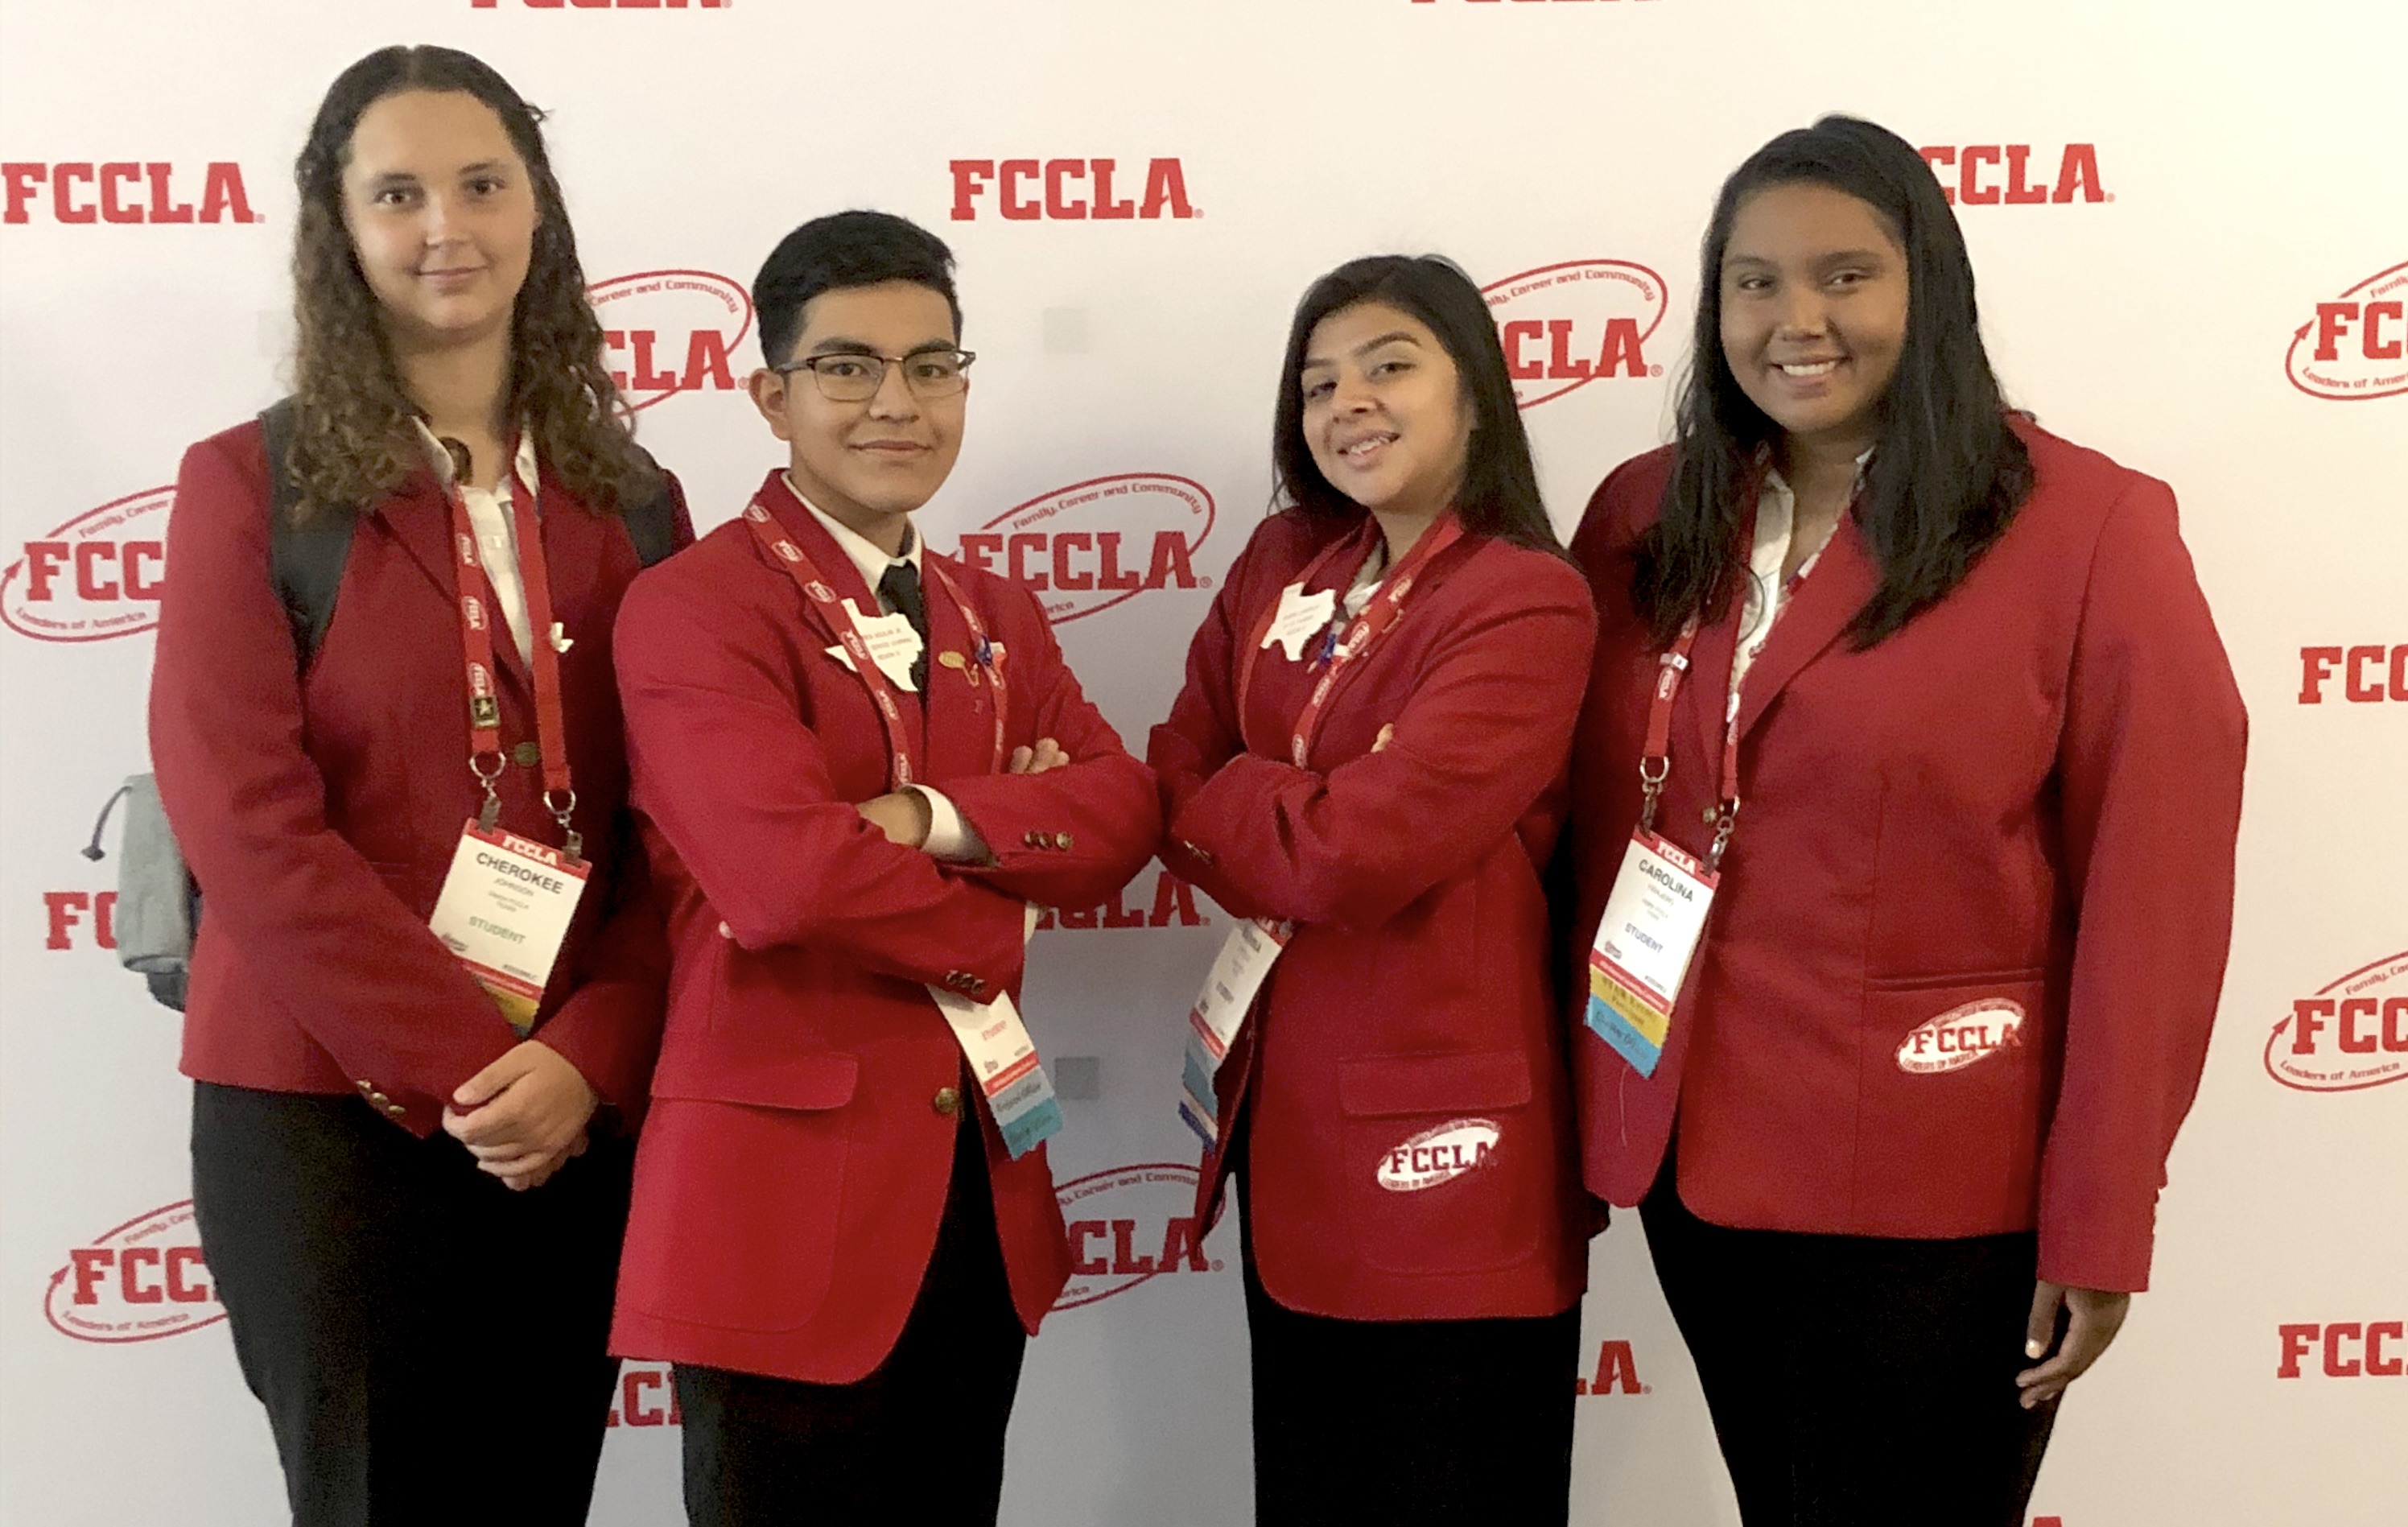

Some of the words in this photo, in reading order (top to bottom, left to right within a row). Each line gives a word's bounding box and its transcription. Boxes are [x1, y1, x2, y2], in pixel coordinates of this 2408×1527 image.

[2, 161, 254, 224] FCCLA
[949, 158, 1193, 221] FCCLA
[637, 281, 662, 294] and
[665, 279, 739, 314] Community
[1556, 270, 1581, 284] and
[1585, 268, 1656, 302] Community
[1058, 491, 1100, 510] Career
[1103, 485, 1129, 497] and
[1132, 483, 1203, 515] Community
[476, 852, 564, 895] CHEROKEE
[1638, 859, 1693, 902] CAROLINA
[468, 915, 527, 944] STUDENT
[1389, 1141, 1497, 1174] FCCLA
[70, 1246, 220, 1306] FCC
[2277, 1322, 2408, 1379] FCC
